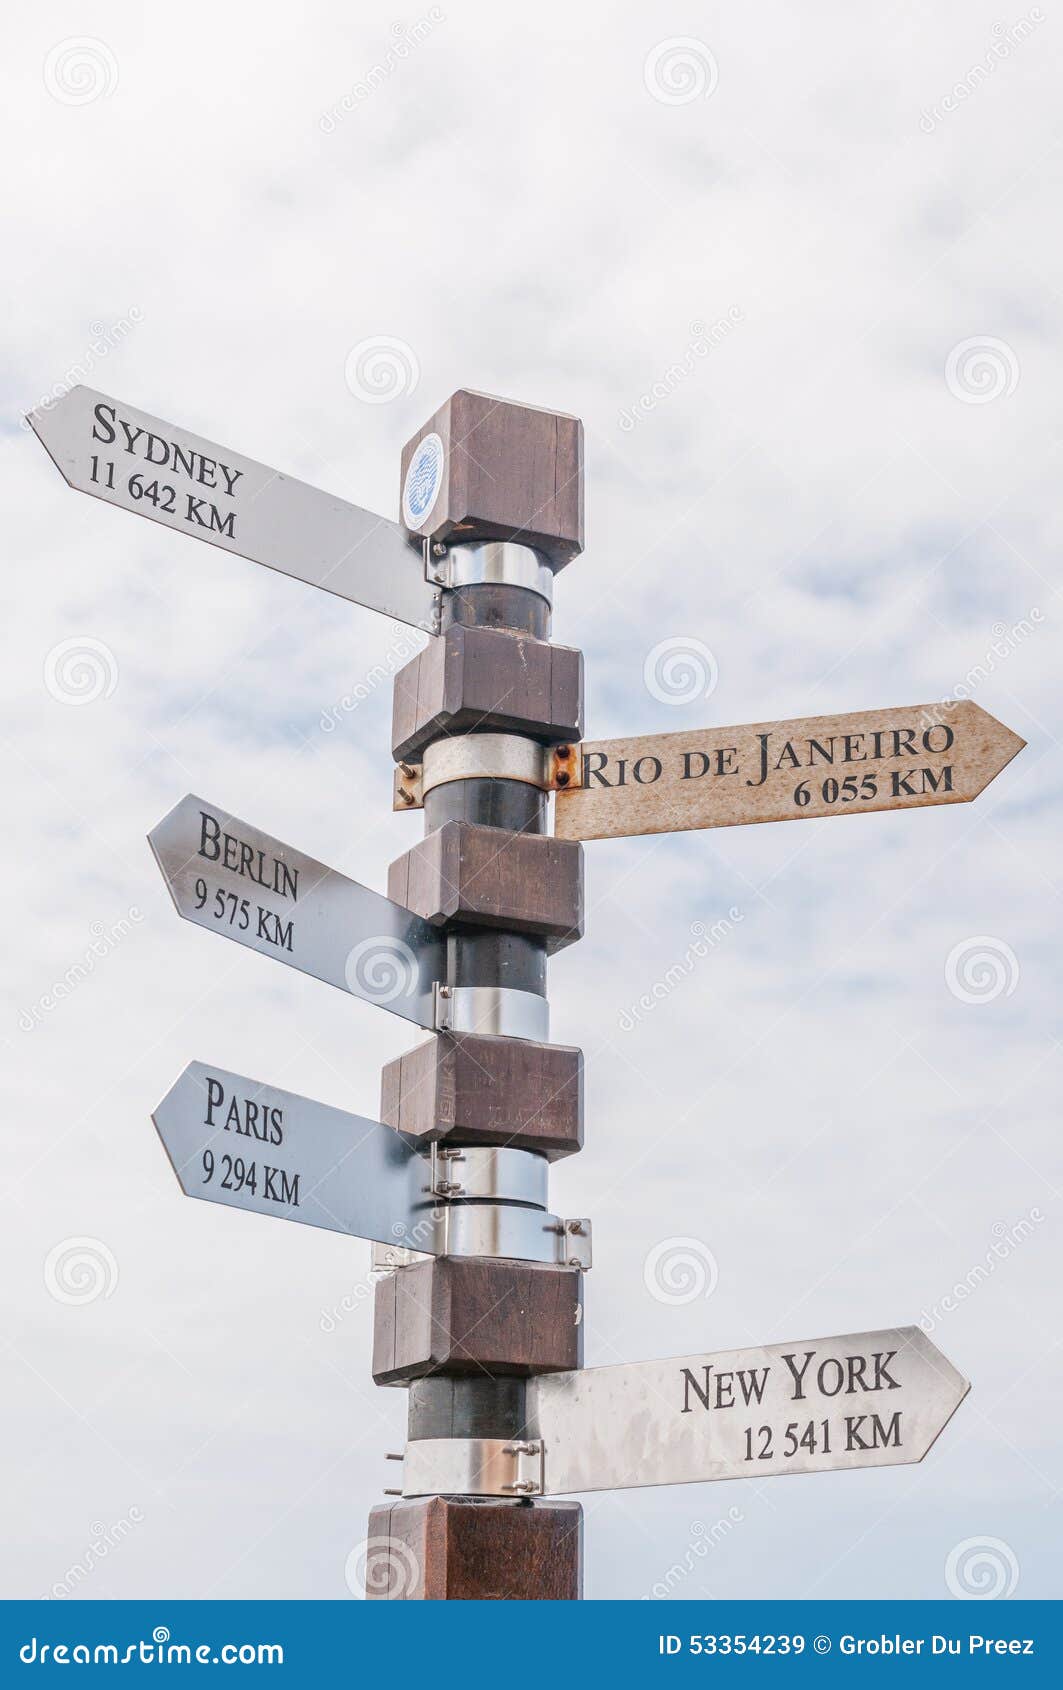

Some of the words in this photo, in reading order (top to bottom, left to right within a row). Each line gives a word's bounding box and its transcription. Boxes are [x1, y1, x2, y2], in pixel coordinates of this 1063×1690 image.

[93, 404, 243, 497] SYDNEY
[90, 456, 115, 489] 11
[128, 474, 176, 513] 642
[184, 494, 237, 539] KM
[581, 752, 662, 790] RIO
[680, 748, 739, 779] DE
[746, 725, 954, 786] JANEIRO
[794, 780, 810, 807] 6
[822, 774, 877, 803] 055
[890, 766, 954, 797] KM
[198, 811, 299, 902] BERLIN
[195, 879, 207, 909] 9
[214, 889, 250, 930] 575
[256, 906, 294, 952] KM
[204, 1077, 282, 1145] PARIS
[202, 1150, 214, 1183] 9
[221, 1155, 257, 1195] 294
[263, 1166, 300, 1207] KM
[680, 1365, 770, 1413] NEW
[781, 1351, 901, 1400] YORK
[744, 1426, 773, 1461] 12
[784, 1419, 831, 1457] 541
[844, 1412, 903, 1451] KM
